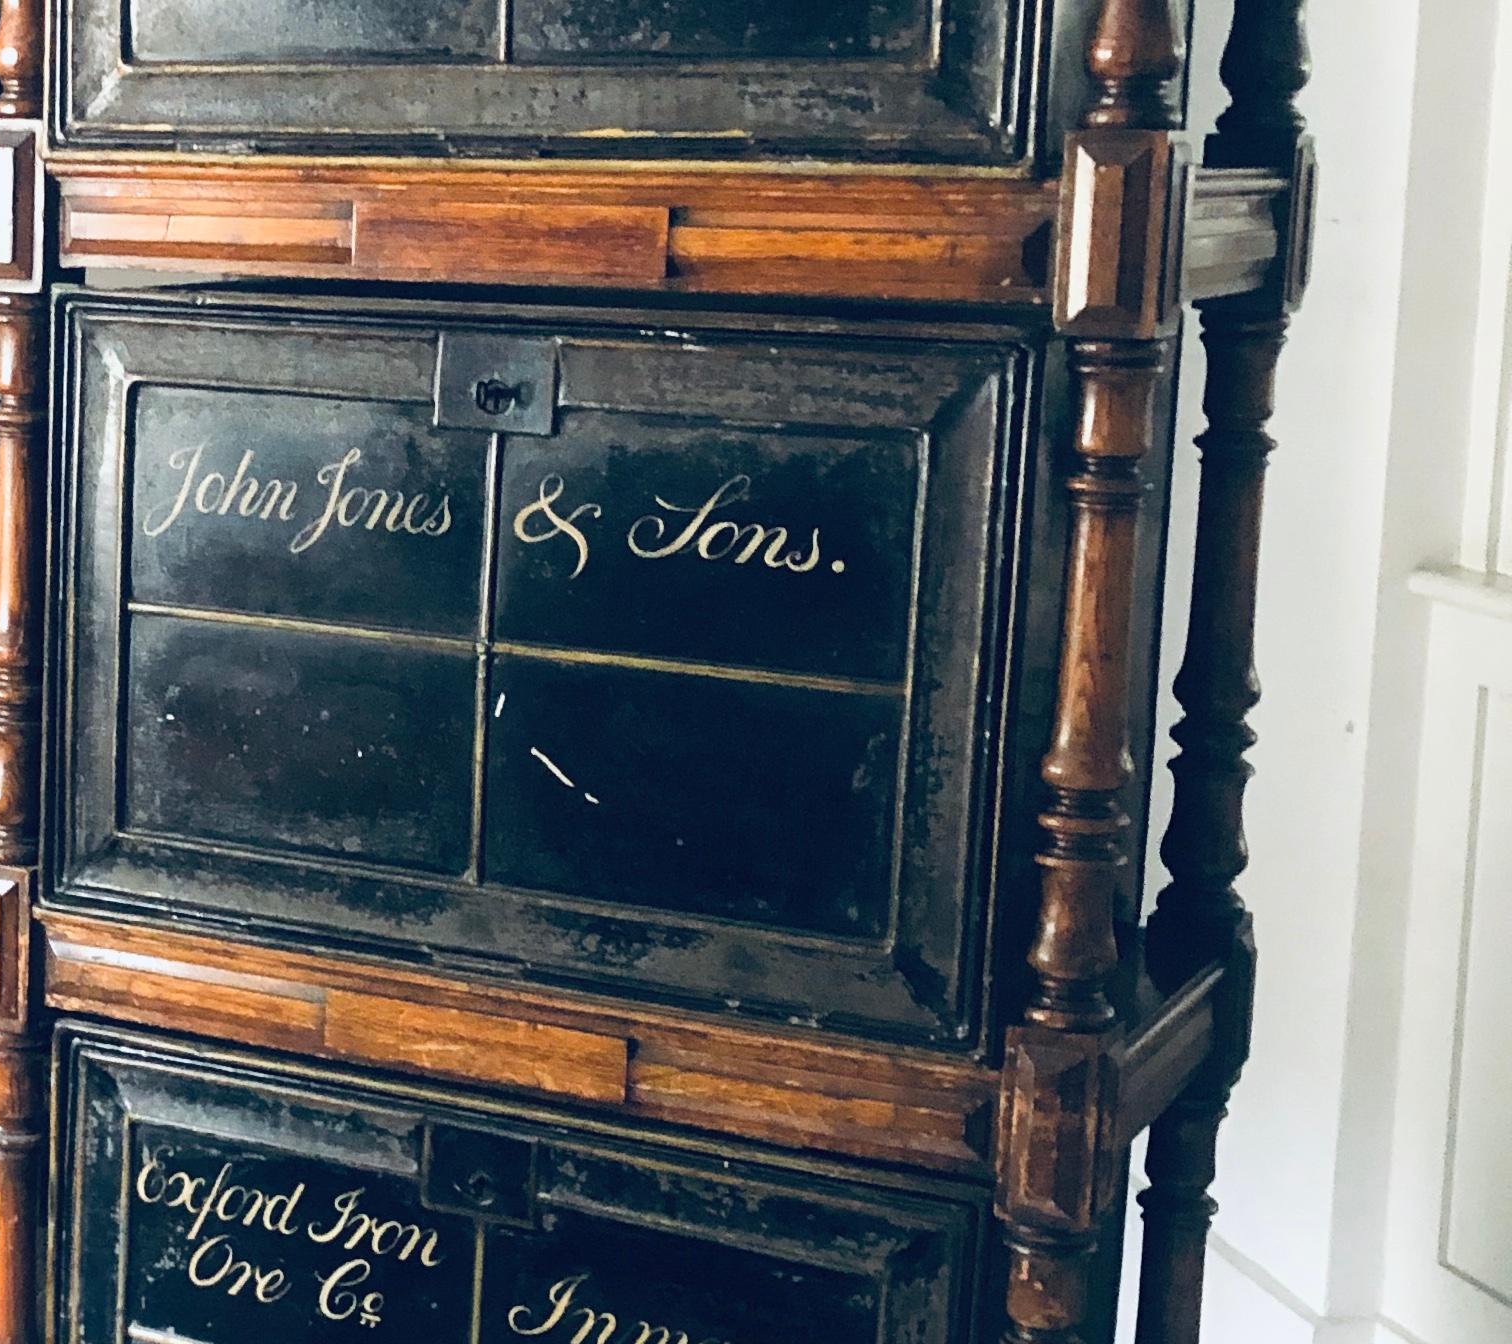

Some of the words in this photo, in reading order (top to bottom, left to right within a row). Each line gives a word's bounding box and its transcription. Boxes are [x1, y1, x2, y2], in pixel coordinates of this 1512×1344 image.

[142, 439, 295, 538] John
[289, 446, 453, 555] Jones
[513, 472, 603, 580] &
[626, 473, 846, 575] Sons.
[306, 1185, 445, 1268] Iron
[188, 1233, 293, 1304] Ore
